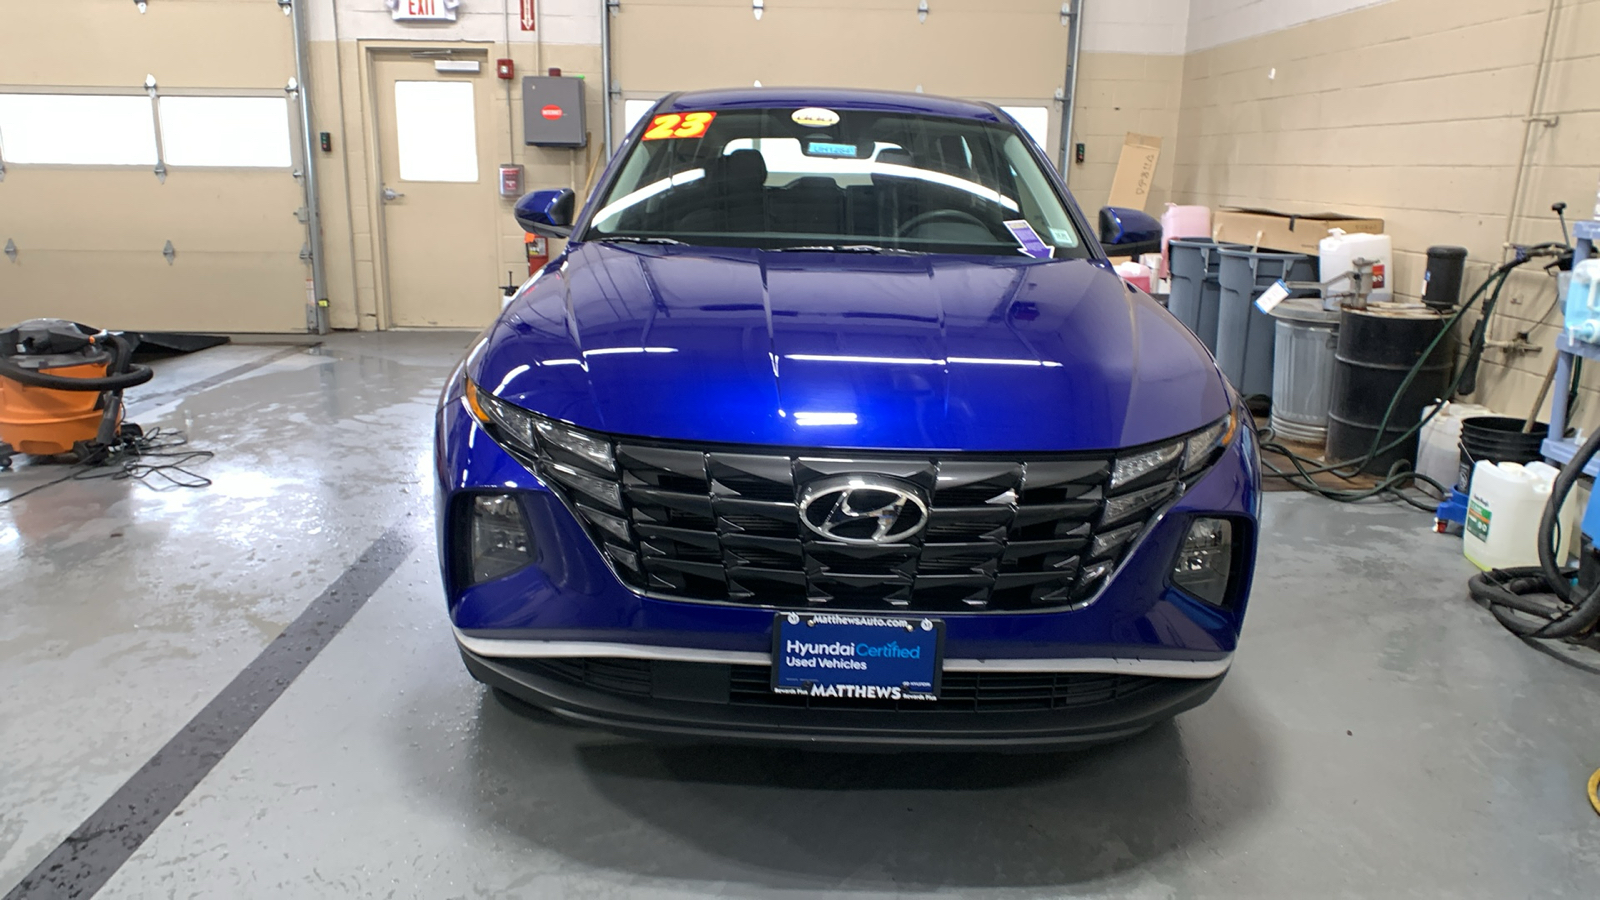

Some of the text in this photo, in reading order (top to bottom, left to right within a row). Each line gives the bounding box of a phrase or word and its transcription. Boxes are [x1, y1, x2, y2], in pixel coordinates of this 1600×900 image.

[644, 112, 712, 138] 23
[812, 614, 908, 628] MatthewsAuto.com
[786, 639, 920, 659] Hyundai Certified
[786, 656, 867, 670] Used Vehicles
[811, 683, 901, 700] MATTHEWS
